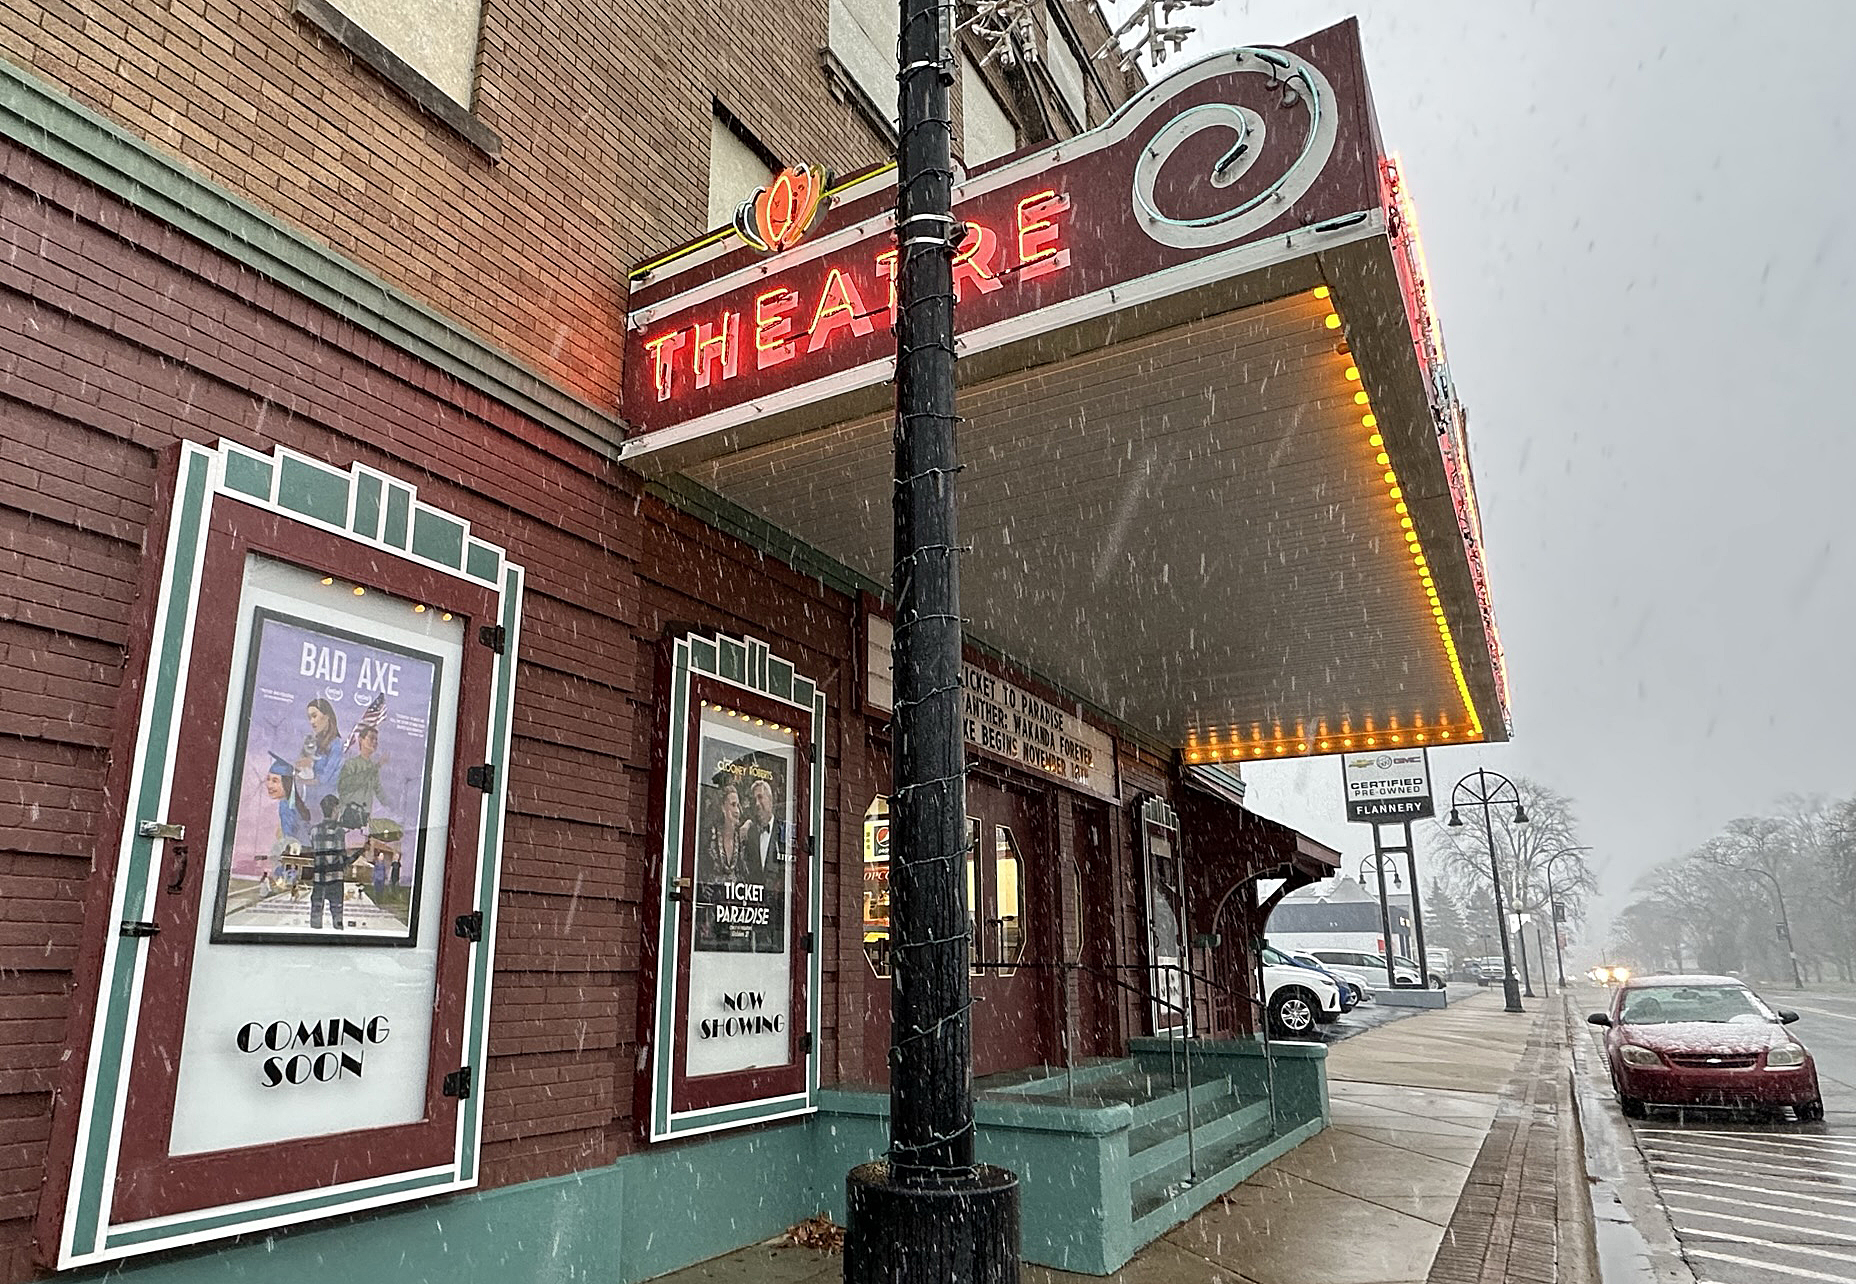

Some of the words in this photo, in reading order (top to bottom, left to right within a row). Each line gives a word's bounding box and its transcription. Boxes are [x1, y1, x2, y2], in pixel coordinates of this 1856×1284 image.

[300, 641, 347, 684] BAD
[357, 657, 401, 697] AXE
[961, 665, 995, 700] ICKET
[1003, 684, 1016, 708] TO
[1021, 694, 1063, 731] PARADISE
[962, 693, 1008, 729] ANTHER:
[1013, 713, 1056, 751] WAKANDA
[1060, 736, 1094, 767] FOREVER
[981, 724, 1018, 757] BEGINS
[1022, 741, 1067, 777] NOVEMBER
[1393, 757, 1421, 765] GMC
[1350, 778, 1423, 790] CERTIFIED
[1354, 786, 1421, 797] PRE-OWNED
[1356, 802, 1422, 815] FLANNERY
[724, 882, 764, 902] TICKET
[716, 905, 770, 925] PARADISE
[723, 991, 766, 1012] NOW
[236, 1015, 390, 1054] COMING
[700, 1013, 786, 1040] SHOWING
[261, 1049, 365, 1088] SOON
